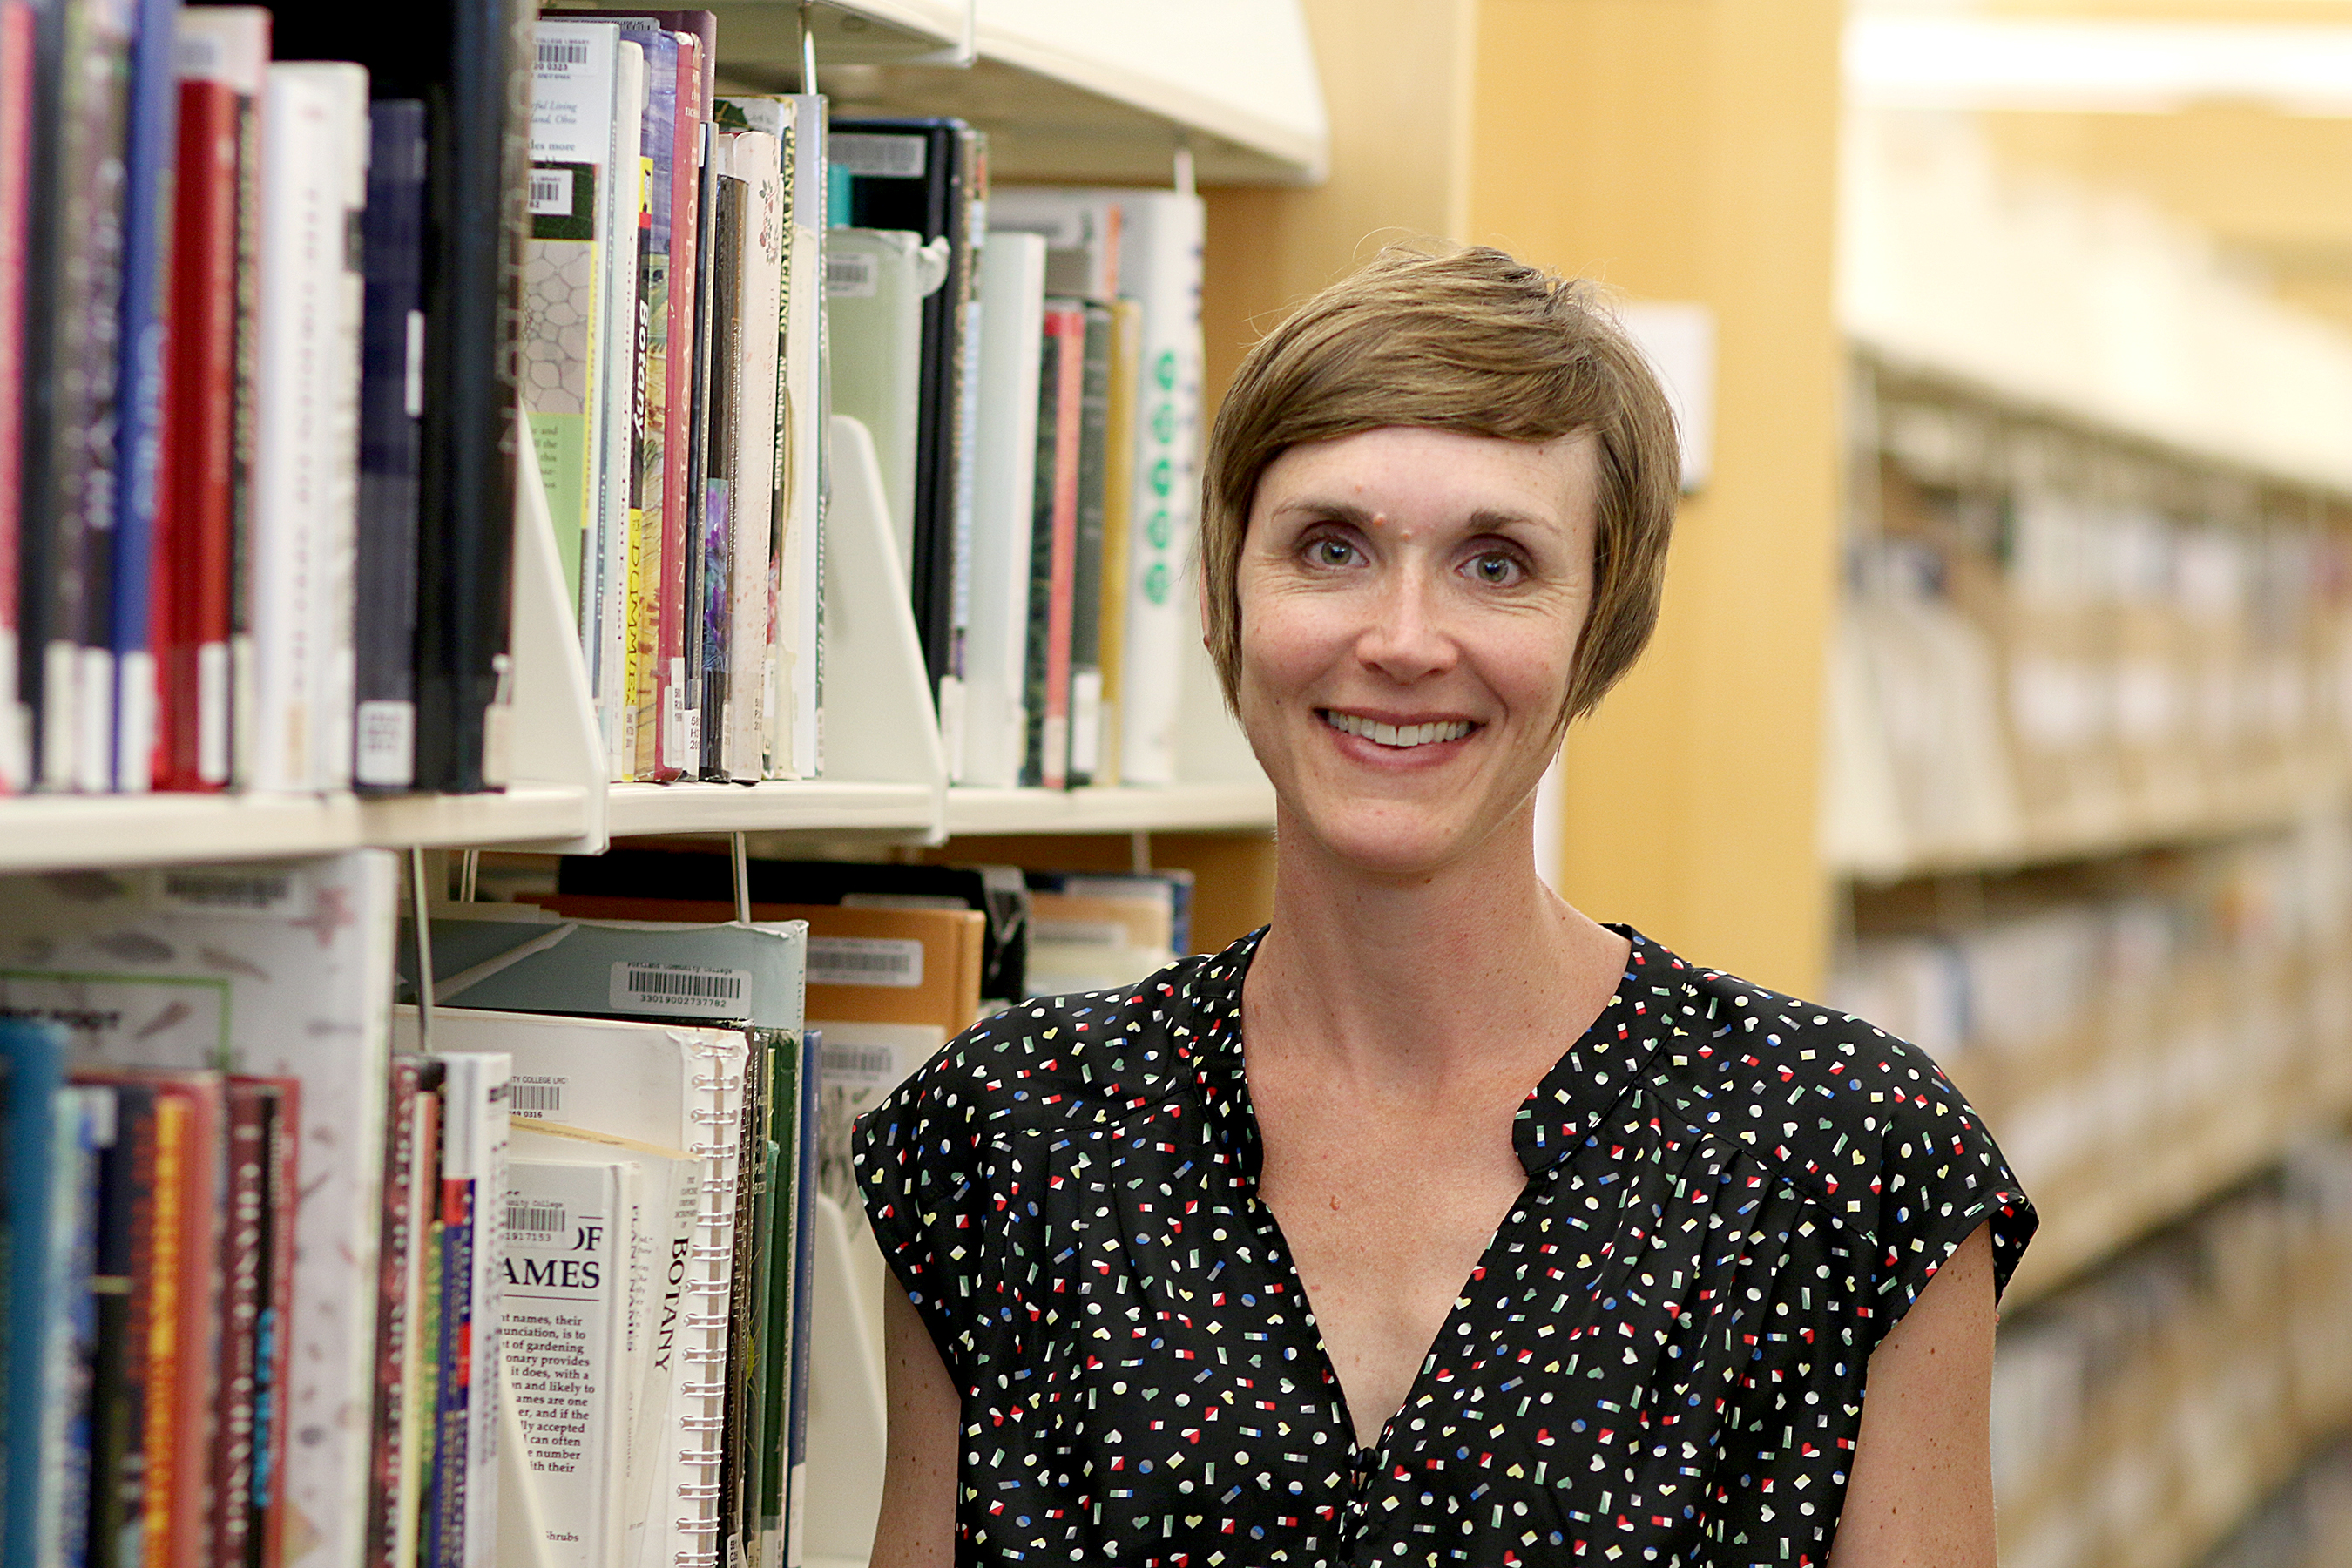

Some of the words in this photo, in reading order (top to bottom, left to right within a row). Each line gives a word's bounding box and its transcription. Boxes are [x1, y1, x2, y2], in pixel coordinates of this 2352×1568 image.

[779, 128, 796, 334] PLANTWATCHING
[682, 145, 699, 366] BIOLOGY
[633, 298, 649, 440] Botany
[776, 355, 787, 426] Malcolm
[774, 428, 785, 490] Wilkins
[677, 462, 688, 647] PLANTS
[640, 994, 727, 1008] 33019002737782
[522, 1076, 551, 1085] COLLEGE
[654, 1236, 690, 1374] BOTANY
[513, 1315, 551, 1325] names,
[555, 1315, 583, 1326] their
[563, 1328, 572, 1339] is
[575, 1330, 586, 1340] to
[512, 1340, 524, 1349] of
[526, 1342, 584, 1355] gardening
[541, 1355, 590, 1368] provides
[522, 1366, 551, 1379] does,
[555, 1369, 580, 1379] with
[524, 1381, 546, 1391] and
[549, 1382, 581, 1396] likely
[585, 1384, 596, 1394] to
[547, 1396, 564, 1405] are
[567, 1397, 588, 1407] one
[536, 1409, 557, 1419] and
[559, 1409, 569, 1419] if
[571, 1409, 590, 1420] the
[537, 1423, 585, 1435] accepted
[530, 1436, 549, 1445] can
[551, 1435, 581, 1446] often
[536, 1449, 582, 1460] number
[548, 1462, 575, 1473] their
